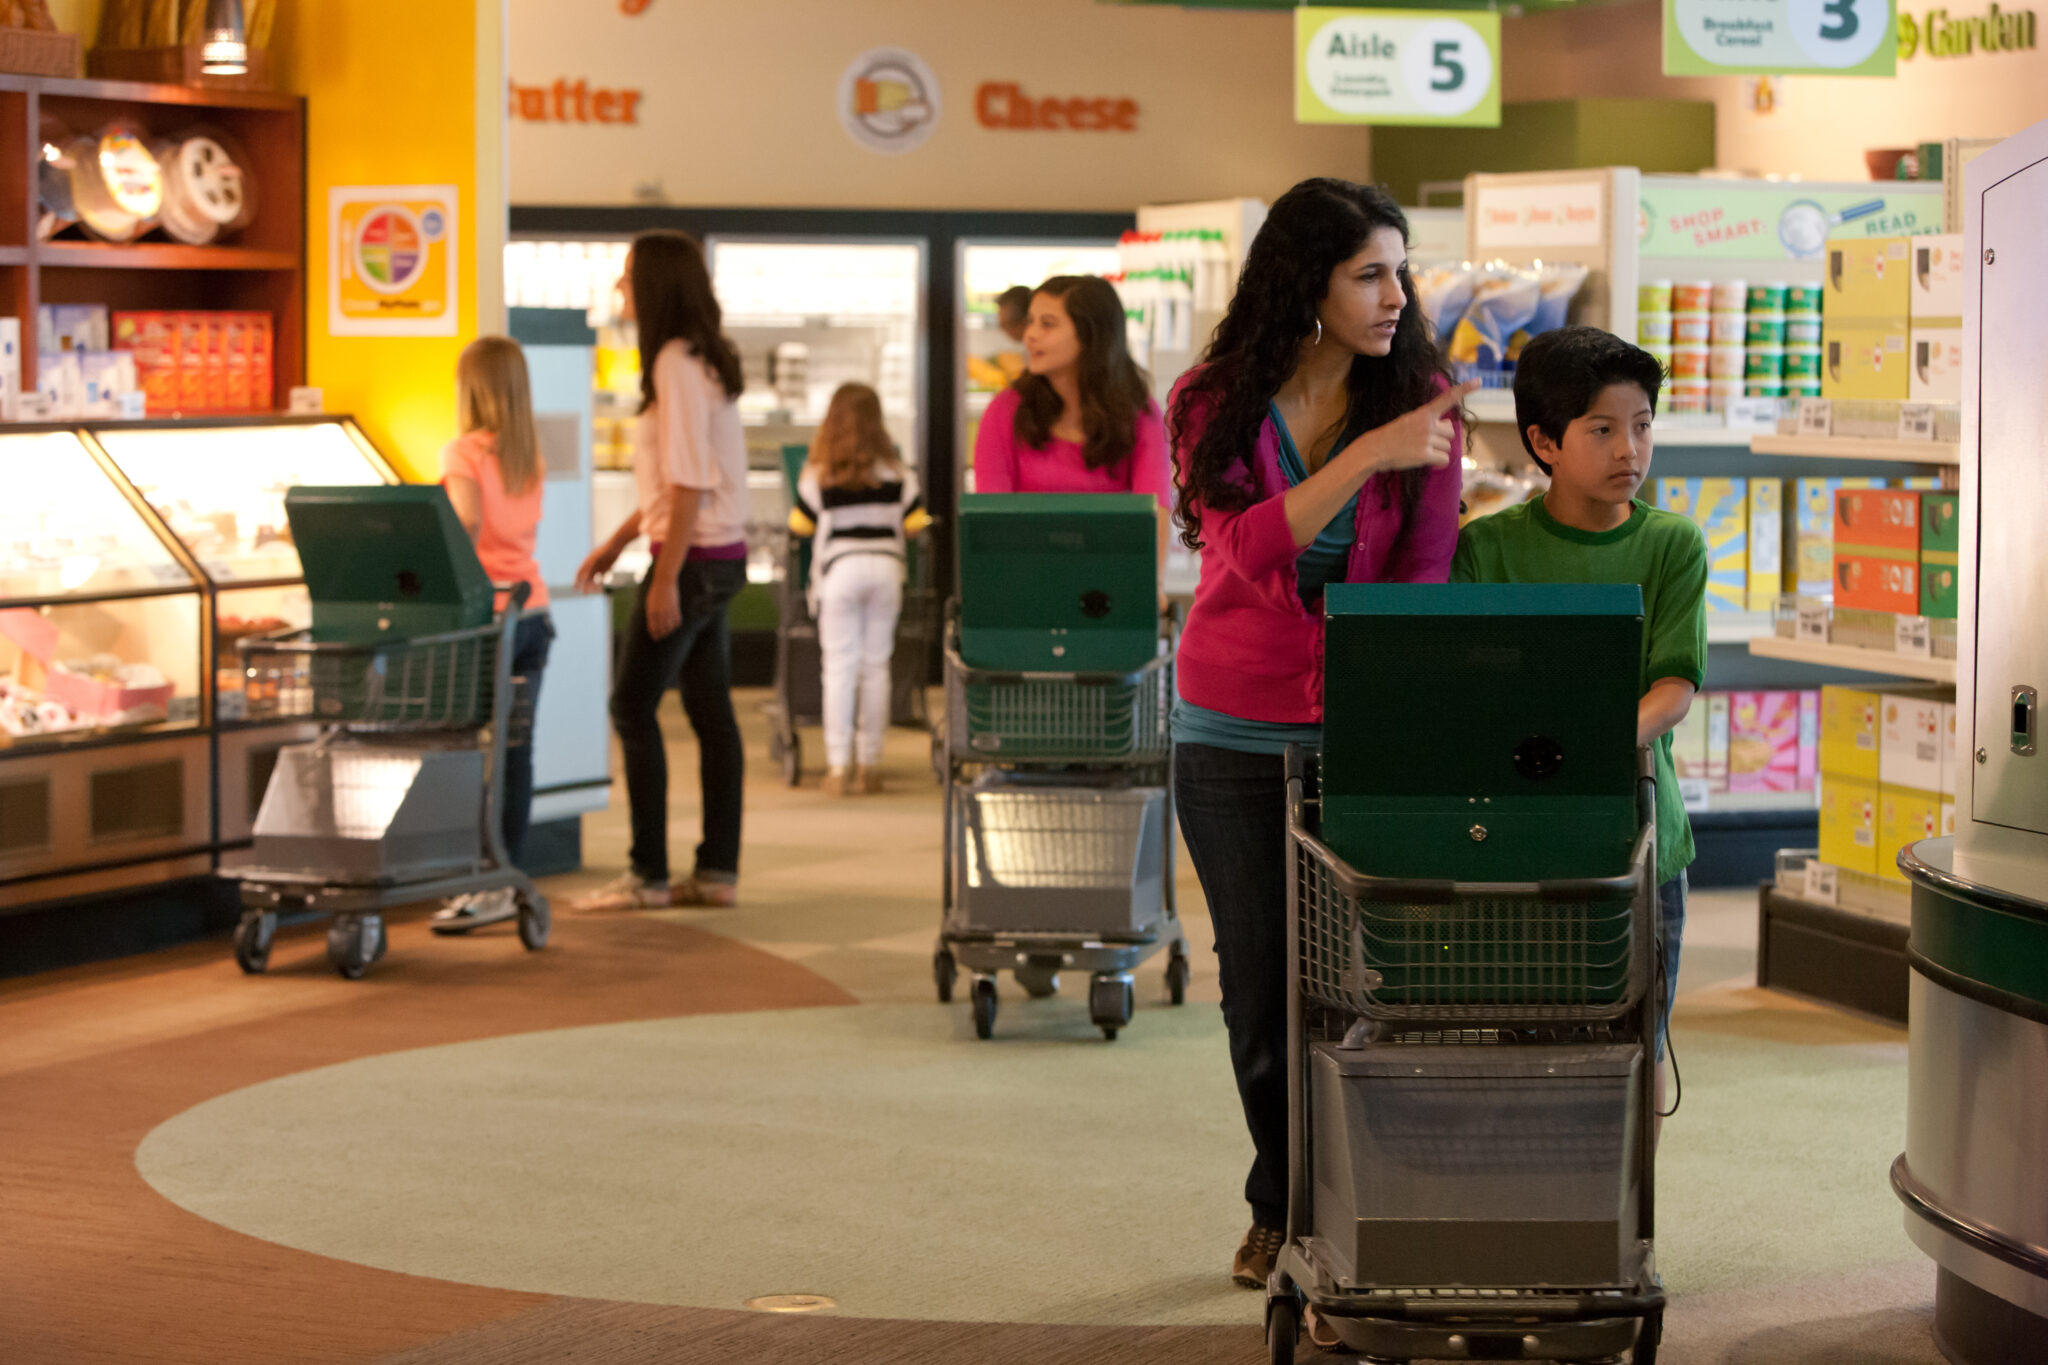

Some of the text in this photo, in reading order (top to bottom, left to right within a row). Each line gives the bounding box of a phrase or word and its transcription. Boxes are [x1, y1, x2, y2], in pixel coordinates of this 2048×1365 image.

[1703, 16, 1774, 31] Breakfast
[1819, 0, 1860, 41] 3
[1926, 3, 2036, 57] Garden
[1328, 33, 1396, 59] Aisle
[1715, 31, 1763, 47] Cereal
[1430, 41, 1466, 91] 5
[509, 78, 642, 124] utter
[975, 81, 1139, 131] Cheese
[1669, 207, 1725, 233] SHOP
[1866, 211, 1917, 236] READ
